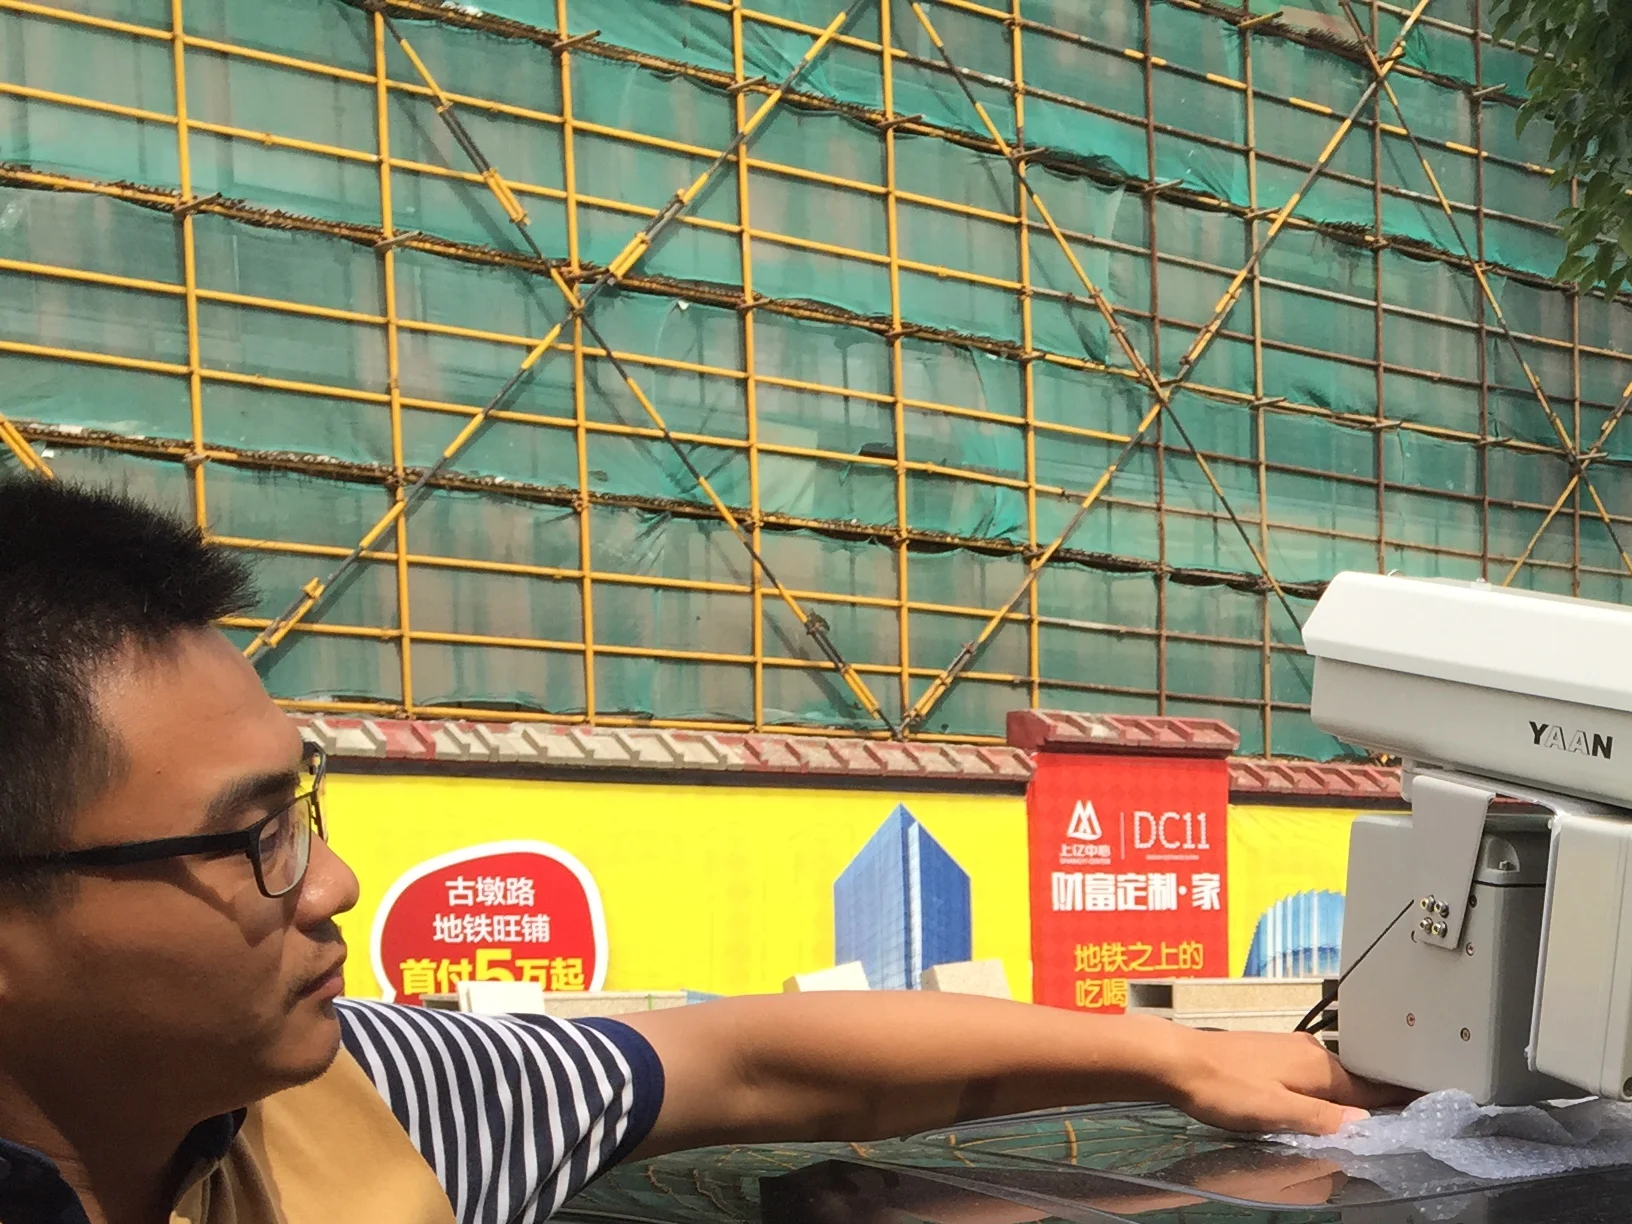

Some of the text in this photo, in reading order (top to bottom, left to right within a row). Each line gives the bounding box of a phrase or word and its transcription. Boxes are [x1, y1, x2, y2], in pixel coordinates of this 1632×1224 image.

[1529, 721, 1613, 759] YAAN
[1134, 811, 1210, 849] DC11
[445, 876, 535, 906] 古墩路
[432, 914, 550, 942] 地铁旺铺
[400, 948, 585, 995] 首付5万起
[1075, 941, 1204, 972] 地铁之上的
